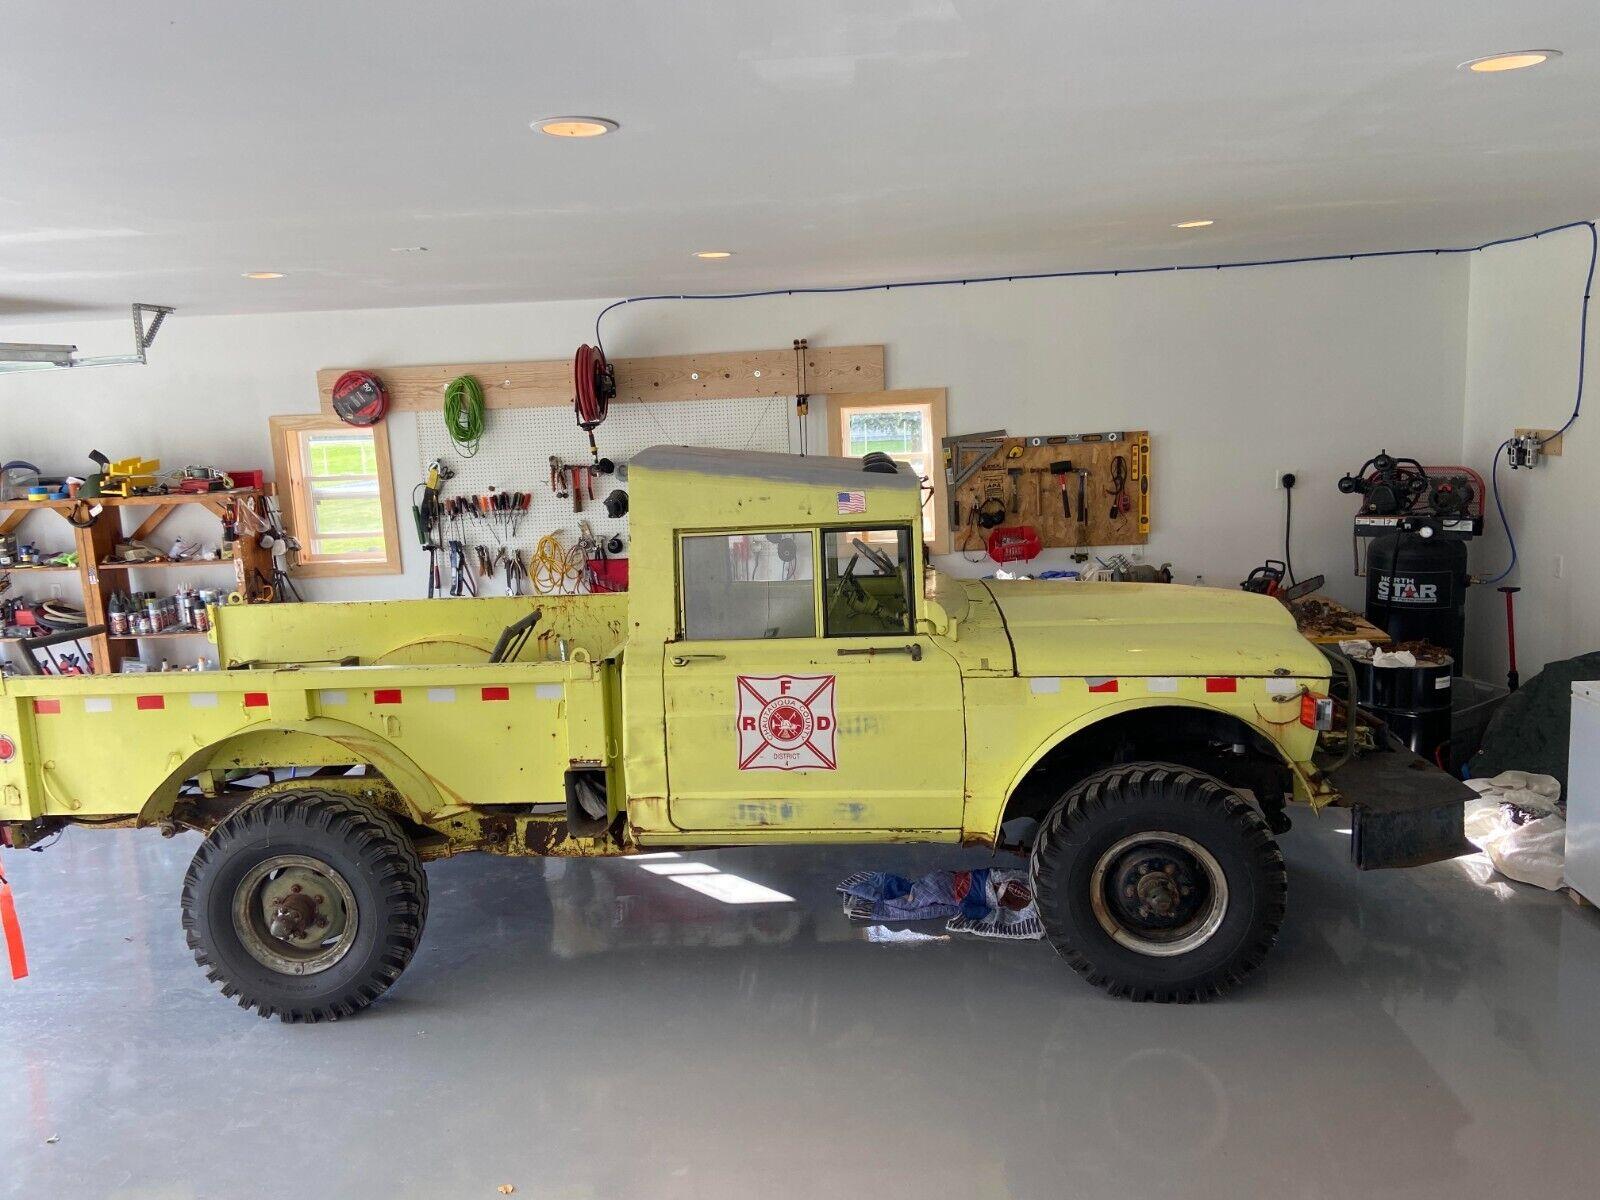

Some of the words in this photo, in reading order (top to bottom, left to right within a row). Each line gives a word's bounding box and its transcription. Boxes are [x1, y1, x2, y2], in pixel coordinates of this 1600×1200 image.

[1377, 581, 1437, 598] STAR
[780, 680, 792, 695] F
[742, 716, 756, 731] R
[762, 699, 796, 741] CHAUTAUQUA
[799, 705, 811, 741] COUNTY
[817, 716, 831, 731] D
